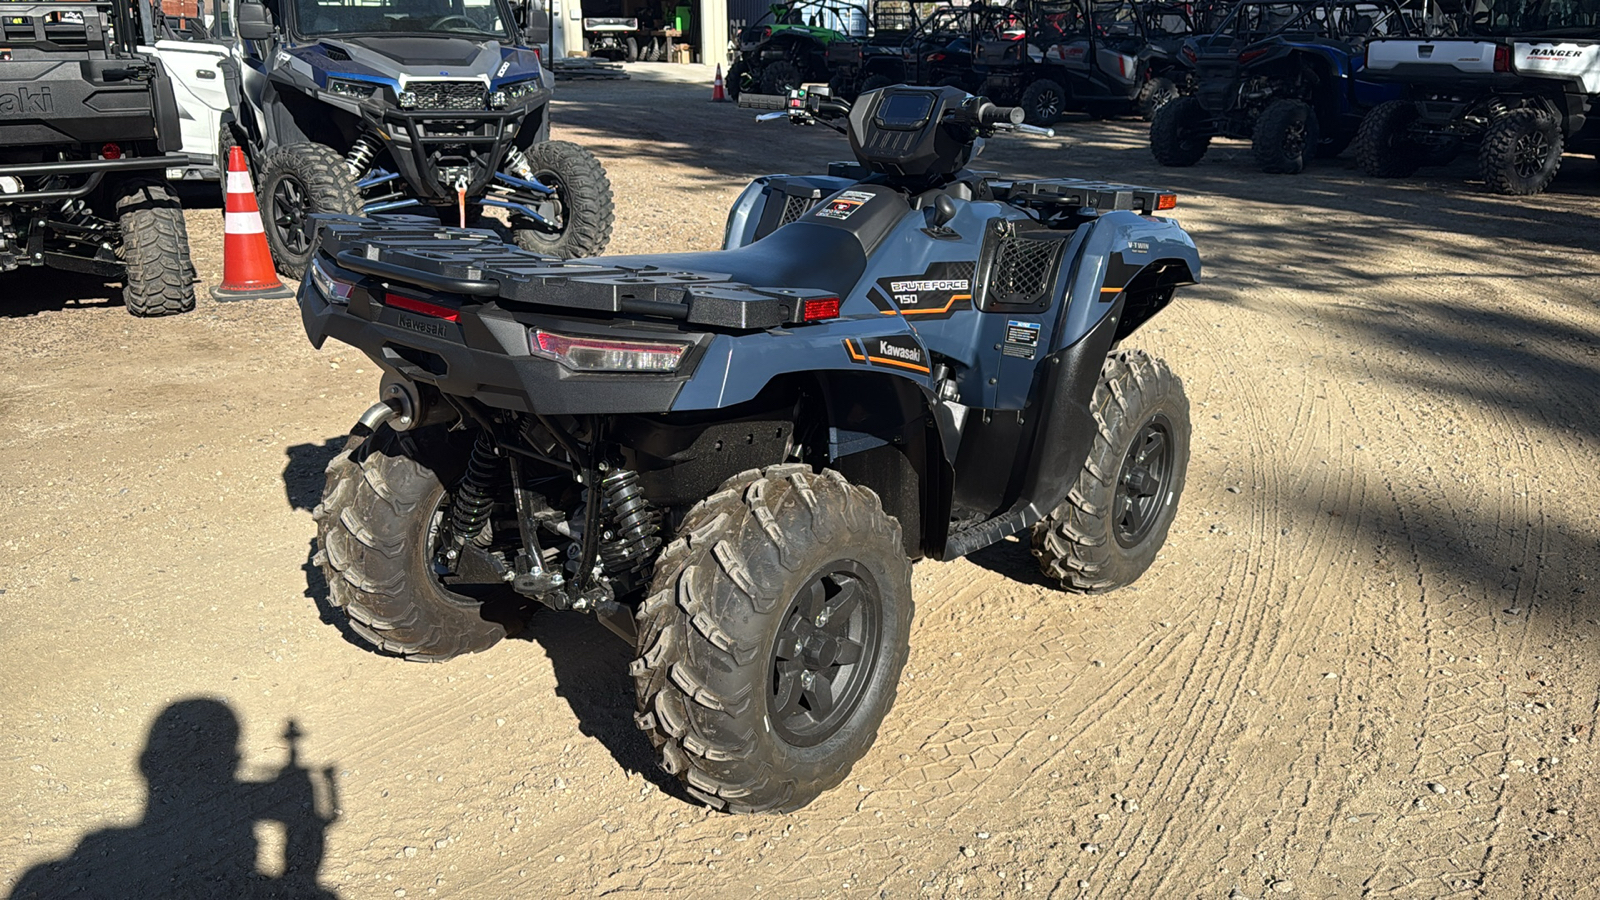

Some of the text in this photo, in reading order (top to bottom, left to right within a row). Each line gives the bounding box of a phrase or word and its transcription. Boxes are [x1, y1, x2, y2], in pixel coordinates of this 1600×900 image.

[1529, 48, 1583, 58] RANGER
[497, 61, 510, 78] 1000
[1127, 241, 1150, 250] V-TWIN
[894, 294, 918, 304] 750
[397, 313, 447, 338] Kawasaki
[879, 340, 922, 362] Kawasaki
